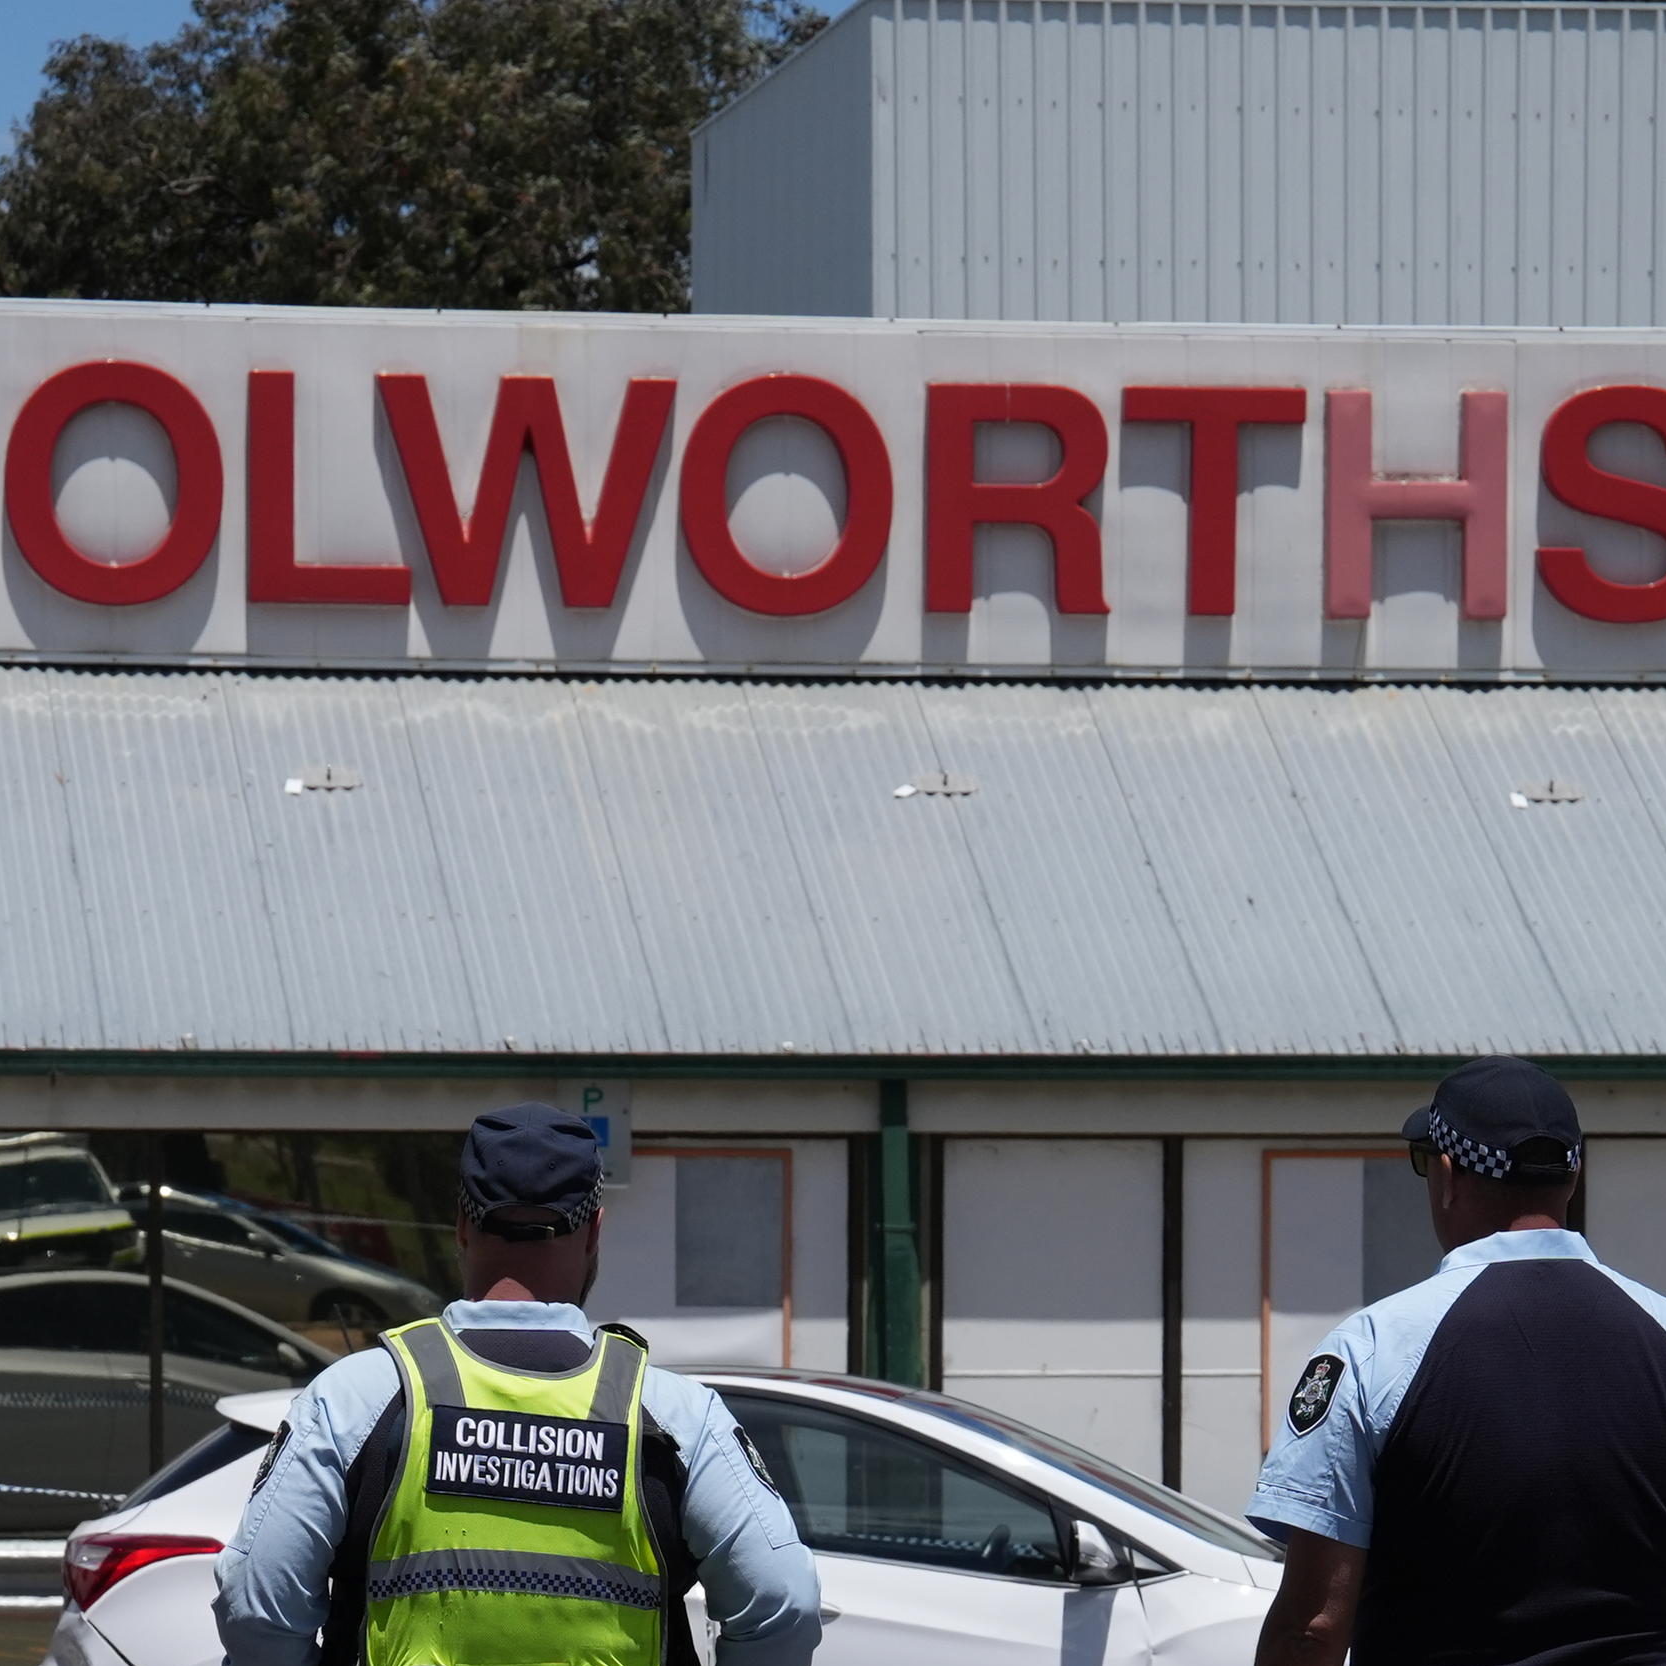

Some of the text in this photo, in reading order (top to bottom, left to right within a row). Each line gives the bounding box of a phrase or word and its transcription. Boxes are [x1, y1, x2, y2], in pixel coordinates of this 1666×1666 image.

[583, 1087, 604, 1114] P
[455, 1416, 605, 1461] COLLISION
[434, 1450, 619, 1499] INVESTIGATIONS
